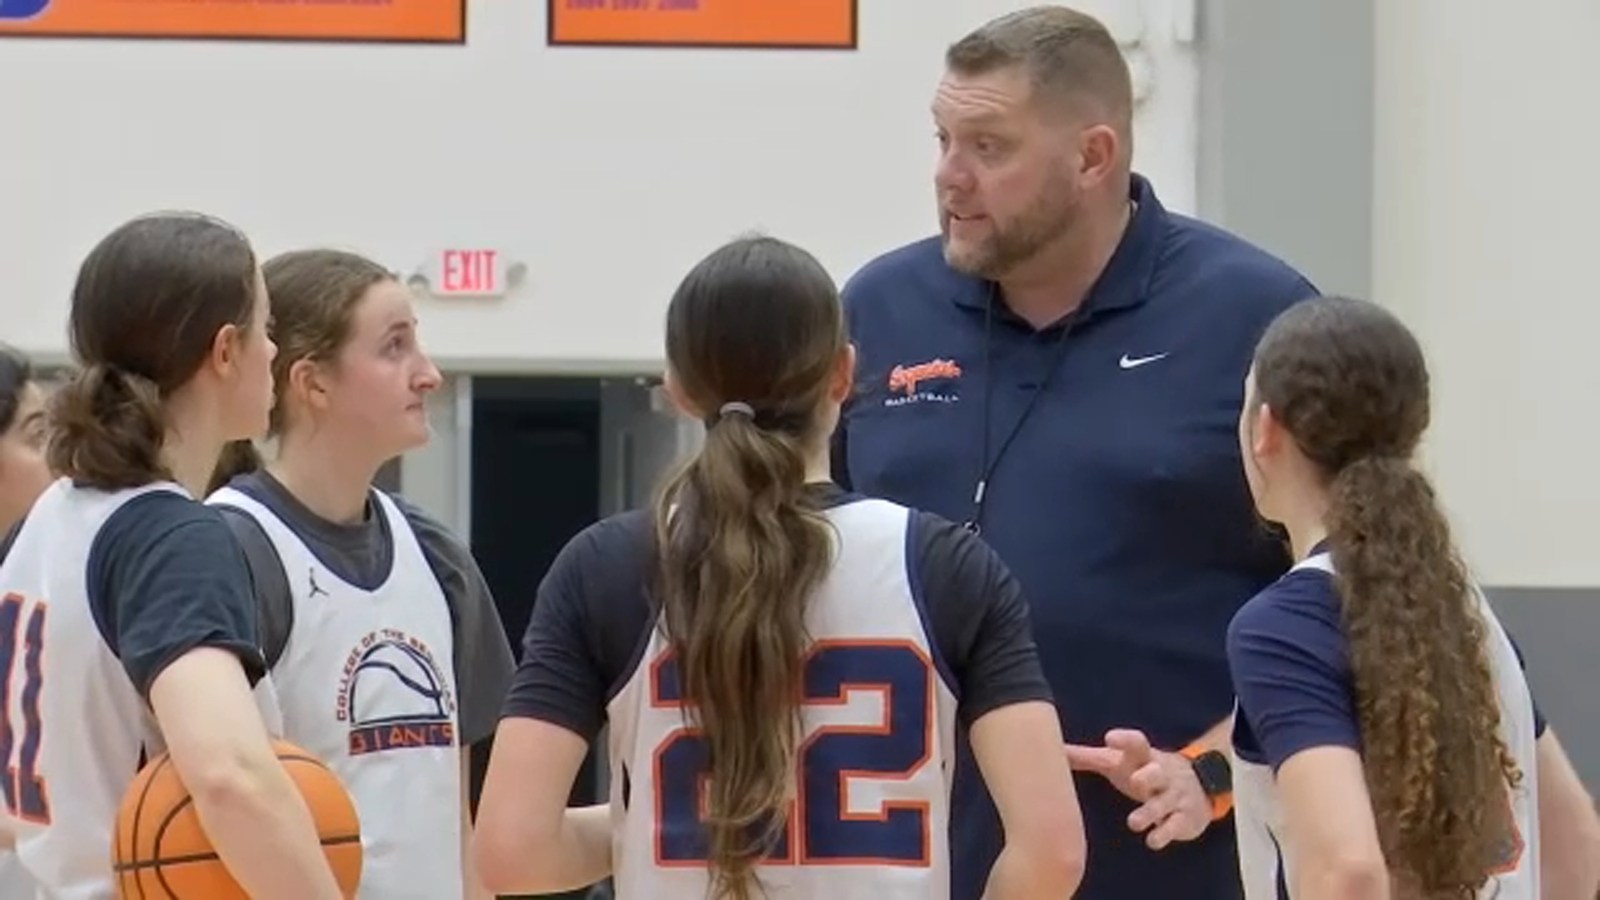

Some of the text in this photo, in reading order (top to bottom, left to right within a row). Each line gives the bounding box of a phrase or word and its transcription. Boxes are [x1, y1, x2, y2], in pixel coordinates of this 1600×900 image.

[443, 249, 497, 291] EXIT
[336, 646, 362, 722] COLLEGE
[361, 631, 377, 649] OF
[380, 629, 405, 641] THE
[650, 638, 934, 867] 22
